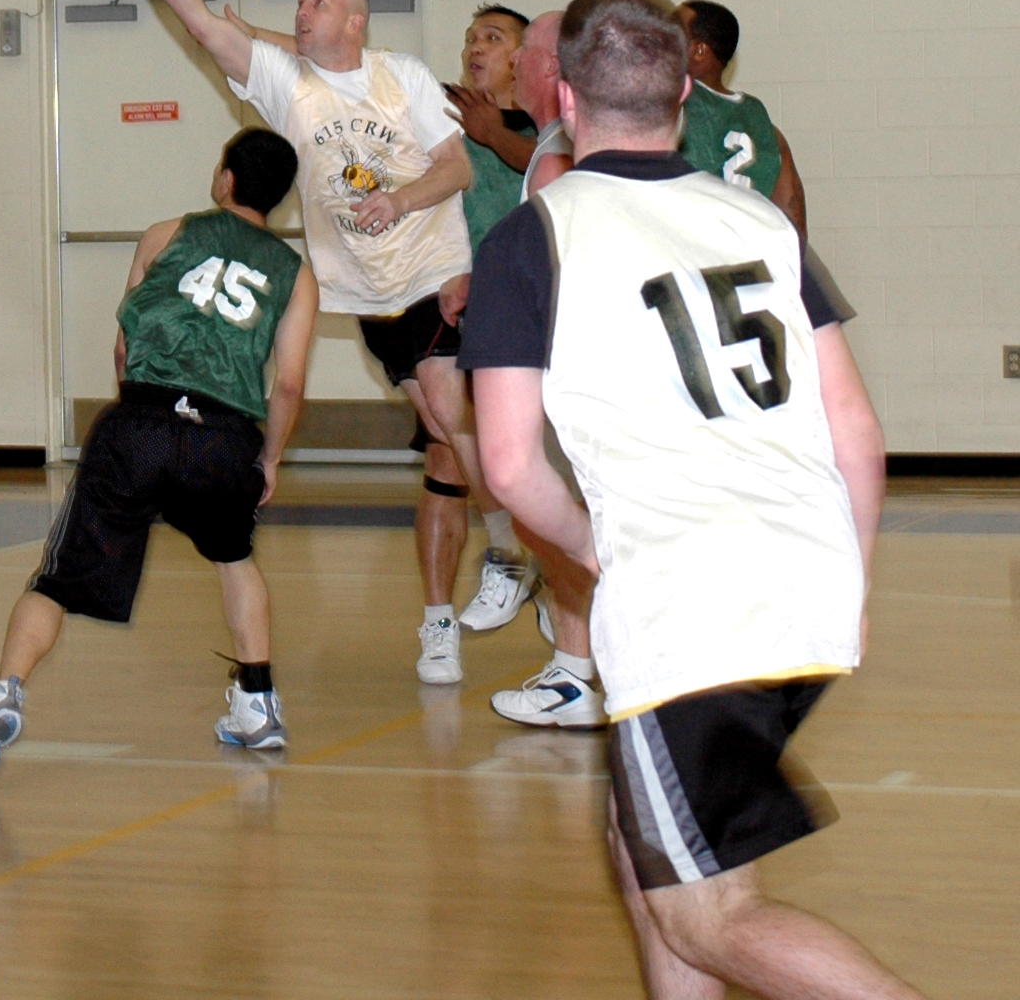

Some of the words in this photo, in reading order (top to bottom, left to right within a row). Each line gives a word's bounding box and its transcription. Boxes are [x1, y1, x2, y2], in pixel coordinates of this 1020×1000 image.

[314, 120, 344, 146] 615
[350, 118, 398, 144] CRW
[722, 130, 752, 189] 2
[178, 256, 268, 322] 45
[640, 259, 792, 420] 15
